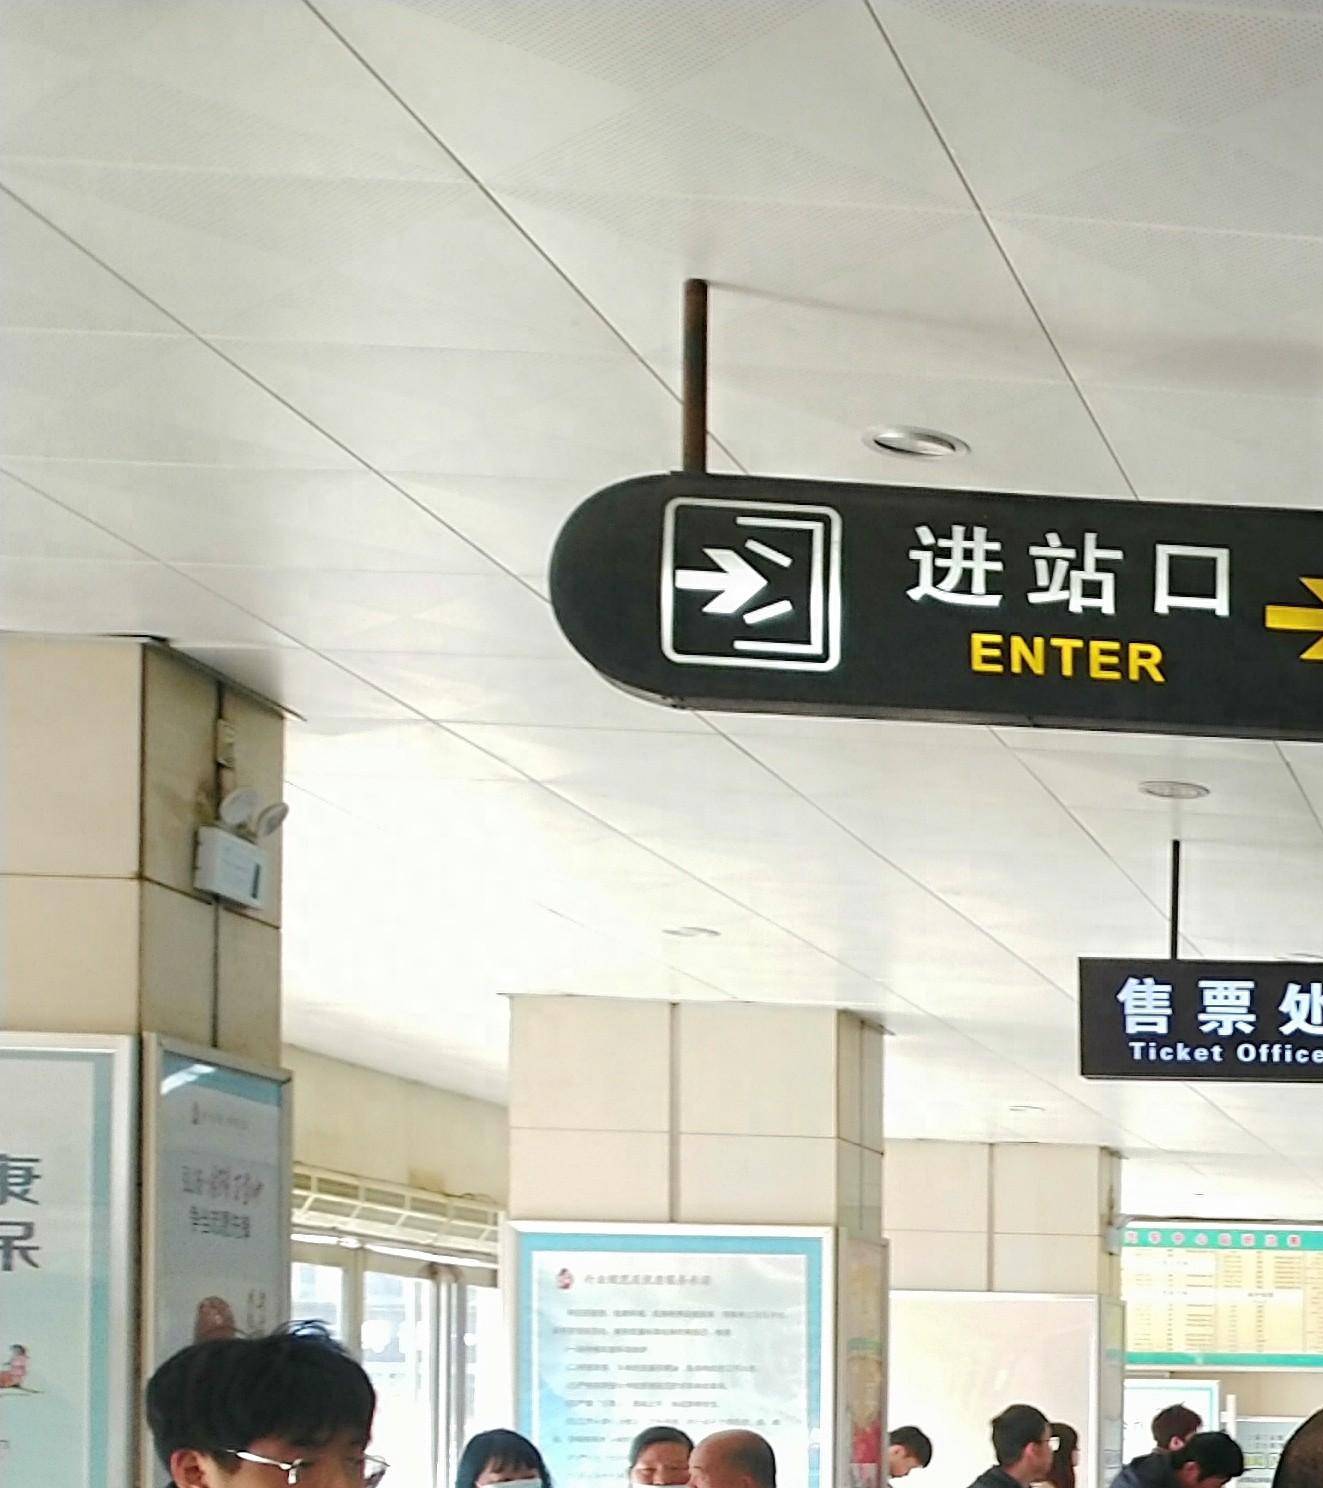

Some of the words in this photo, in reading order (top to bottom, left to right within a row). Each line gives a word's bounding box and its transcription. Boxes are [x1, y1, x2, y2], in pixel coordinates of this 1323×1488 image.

[906, 523, 1231, 618] 进站口
[968, 631, 1166, 682] ENTER
[1129, 1041, 1223, 1063] Ticket
